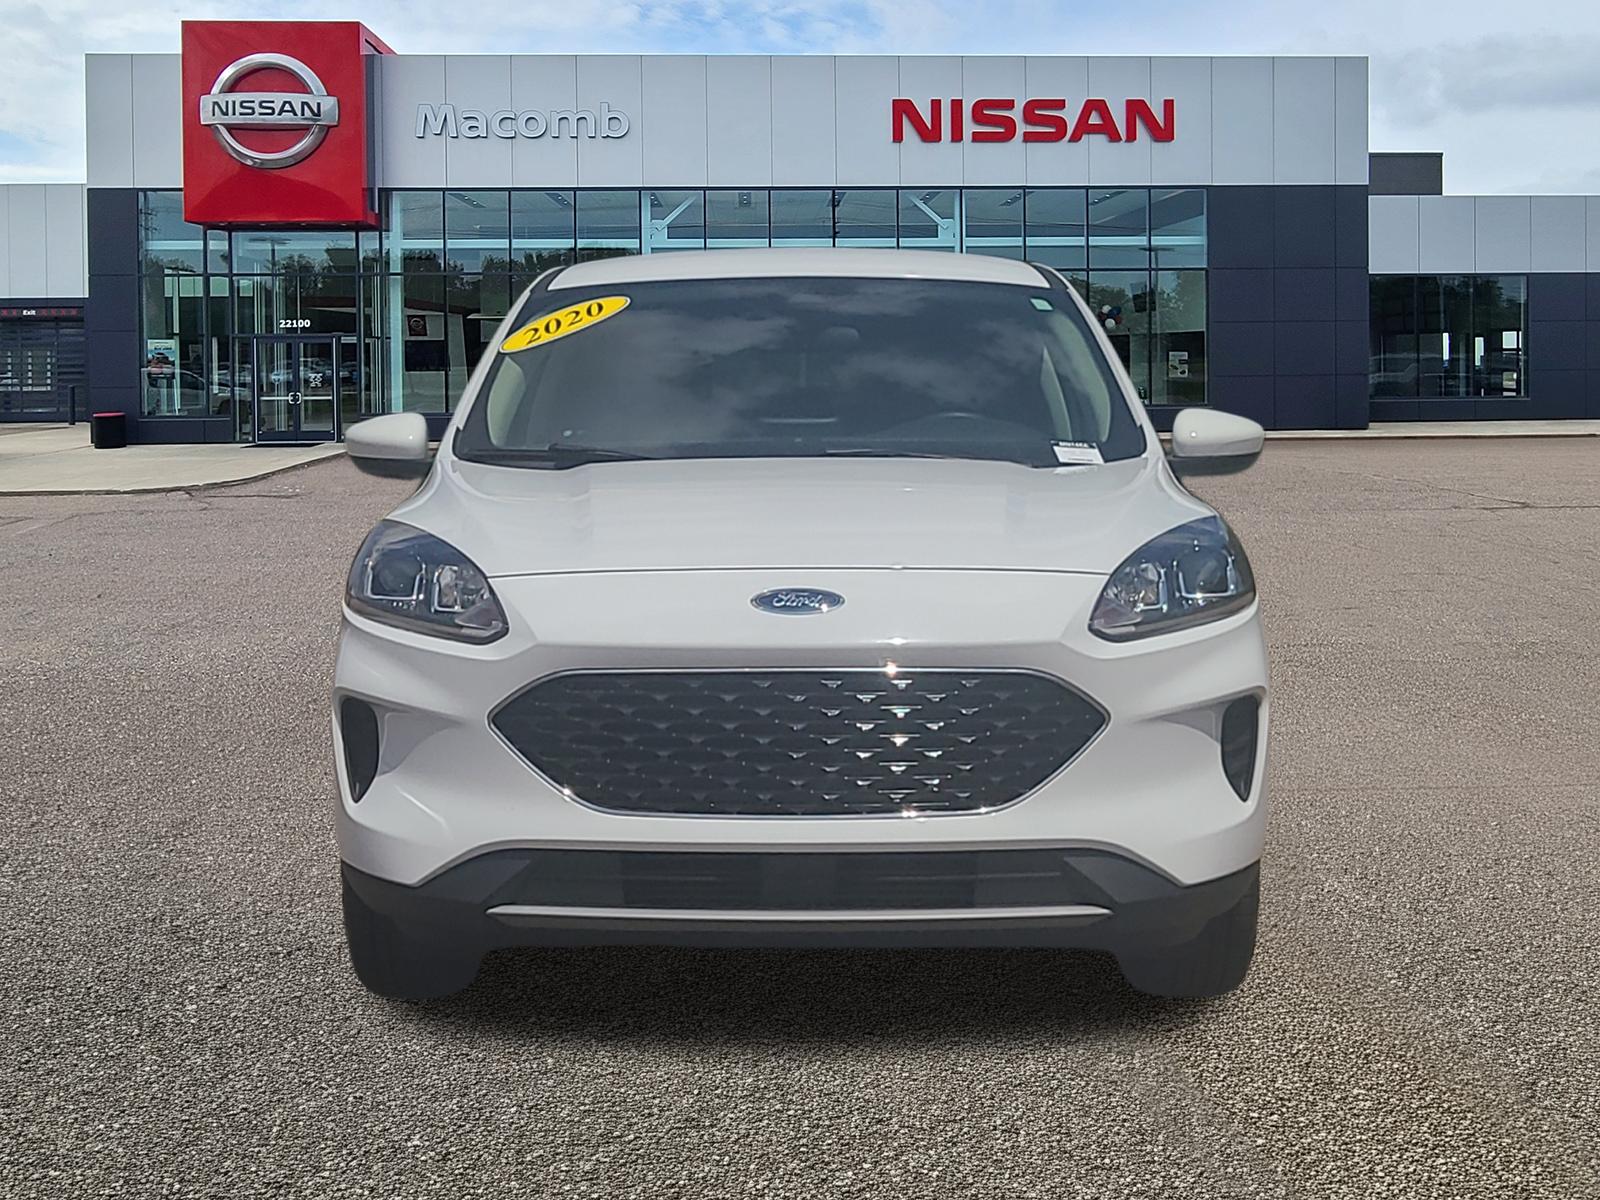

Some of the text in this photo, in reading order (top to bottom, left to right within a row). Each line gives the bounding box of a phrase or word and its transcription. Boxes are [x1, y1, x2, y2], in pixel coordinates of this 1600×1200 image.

[211, 100, 322, 118] NISSAN
[415, 102, 631, 139] Macomb
[892, 98, 1176, 143] NISSAN
[279, 319, 311, 328] 22100
[522, 301, 604, 346] 2020
[772, 591, 824, 607] Ford
